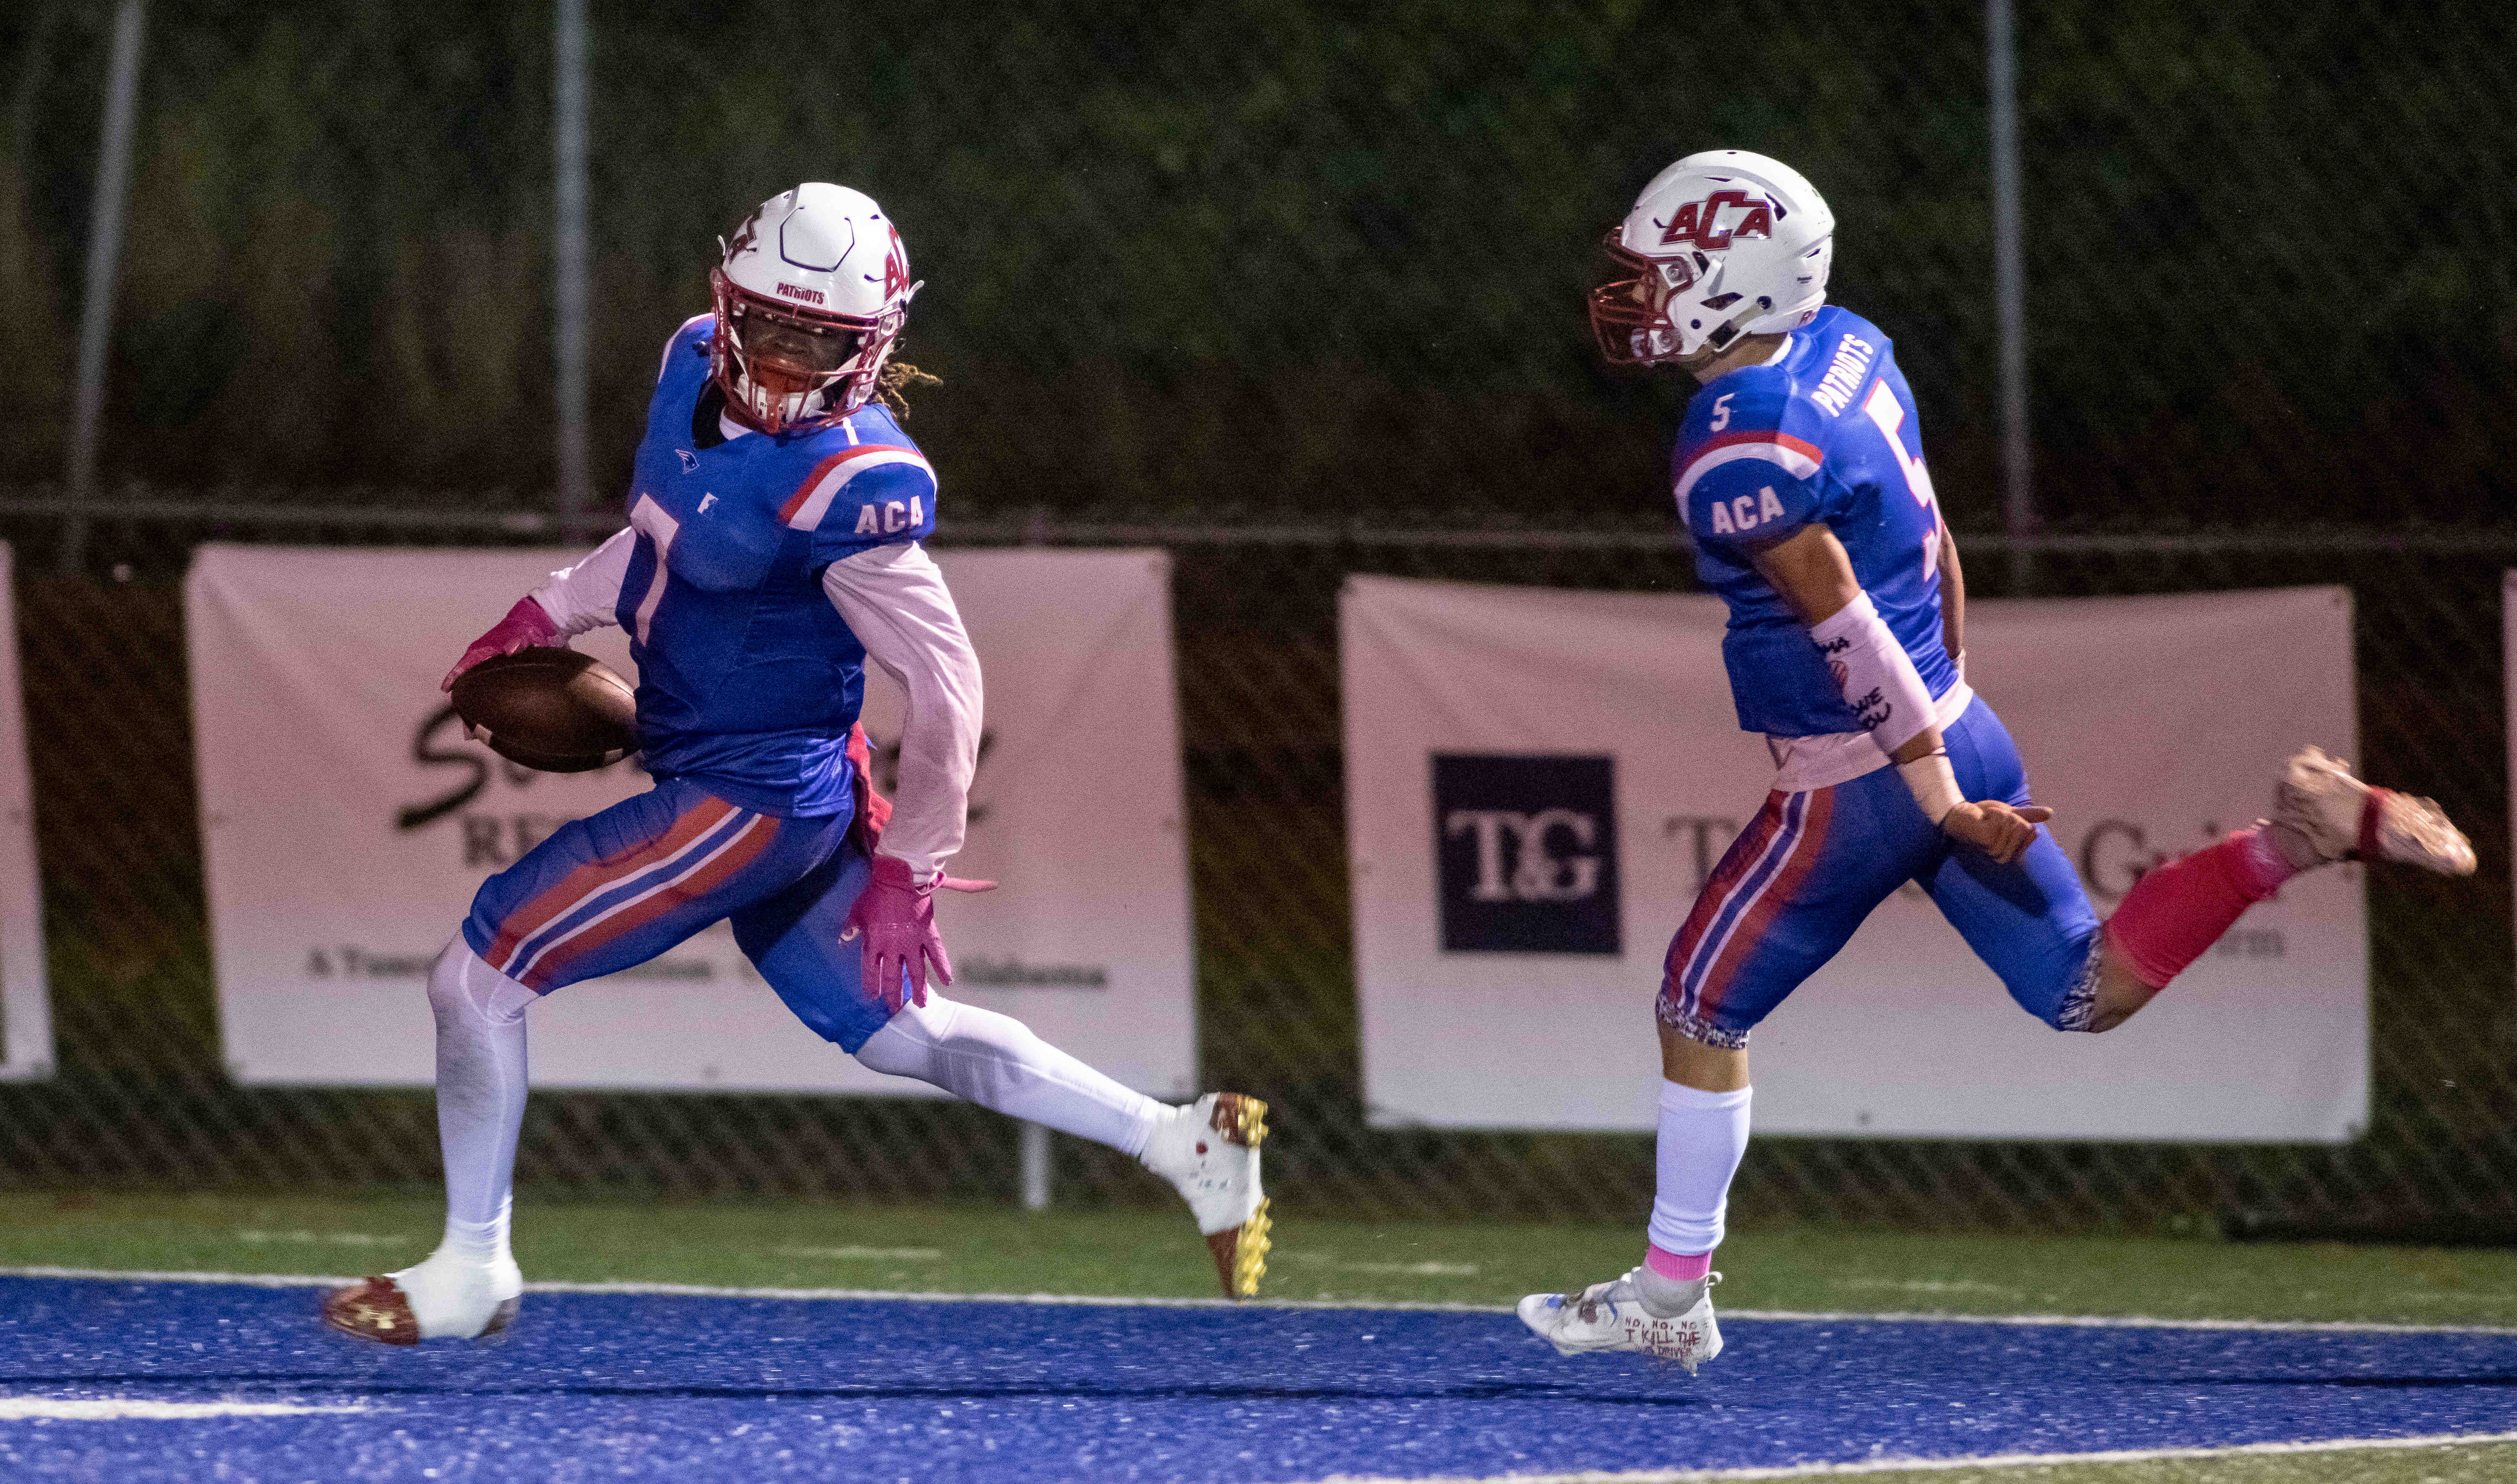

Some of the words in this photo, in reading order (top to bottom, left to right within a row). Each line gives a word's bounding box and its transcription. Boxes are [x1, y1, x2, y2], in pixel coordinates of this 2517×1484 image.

[1660, 190, 1772, 250] ACA
[777, 282, 825, 304] PATRIOTS
[1811, 333, 1874, 417] PATRIOTS
[1710, 393, 1735, 432] 5
[855, 495, 923, 534] ACA
[1712, 485, 1785, 534] ACA
[1445, 806, 1602, 903] T&G
[1625, 1329, 1635, 1342] I
[1642, 1329, 1673, 1345] KILL
[1676, 1331, 1701, 1346] THE
